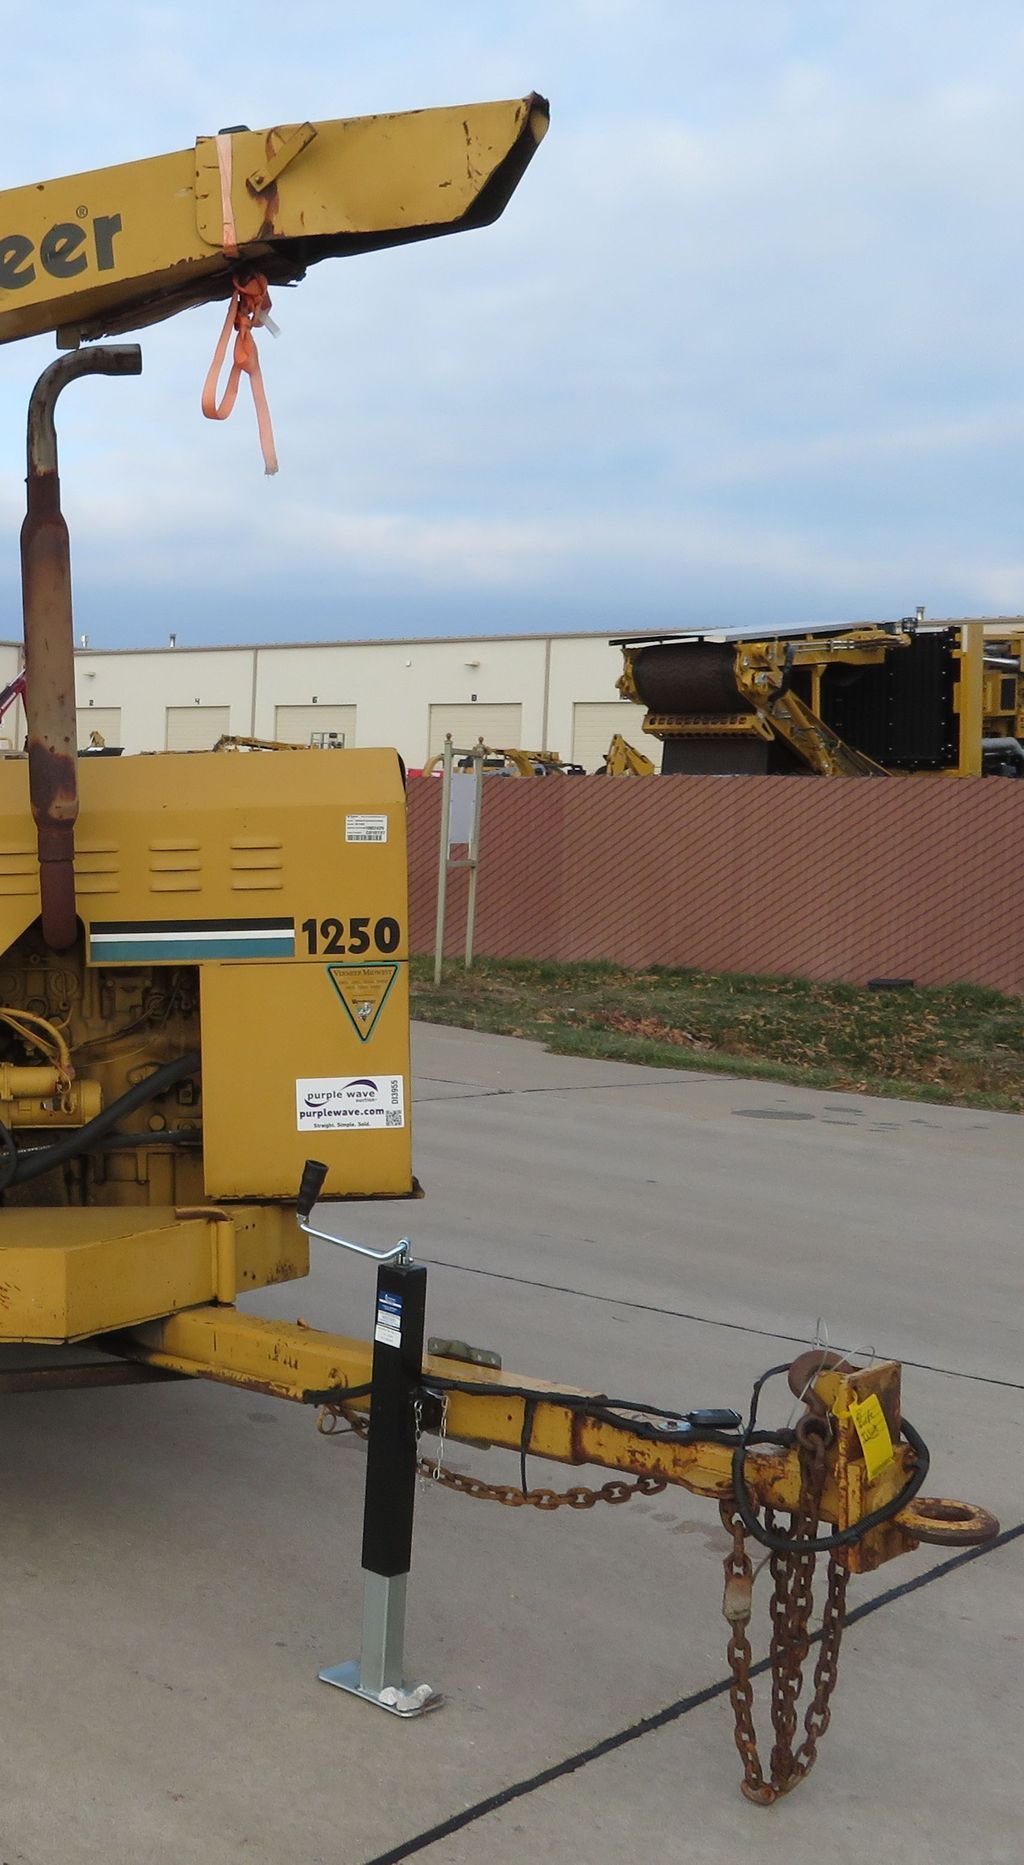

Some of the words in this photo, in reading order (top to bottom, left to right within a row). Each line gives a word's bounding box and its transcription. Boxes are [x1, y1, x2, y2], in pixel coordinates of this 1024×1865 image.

[301, 916, 401, 955] 1250
[307, 1090, 343, 1101] purple
[346, 1090, 376, 1098] wave
[299, 1107, 385, 1120] purplewave.com
